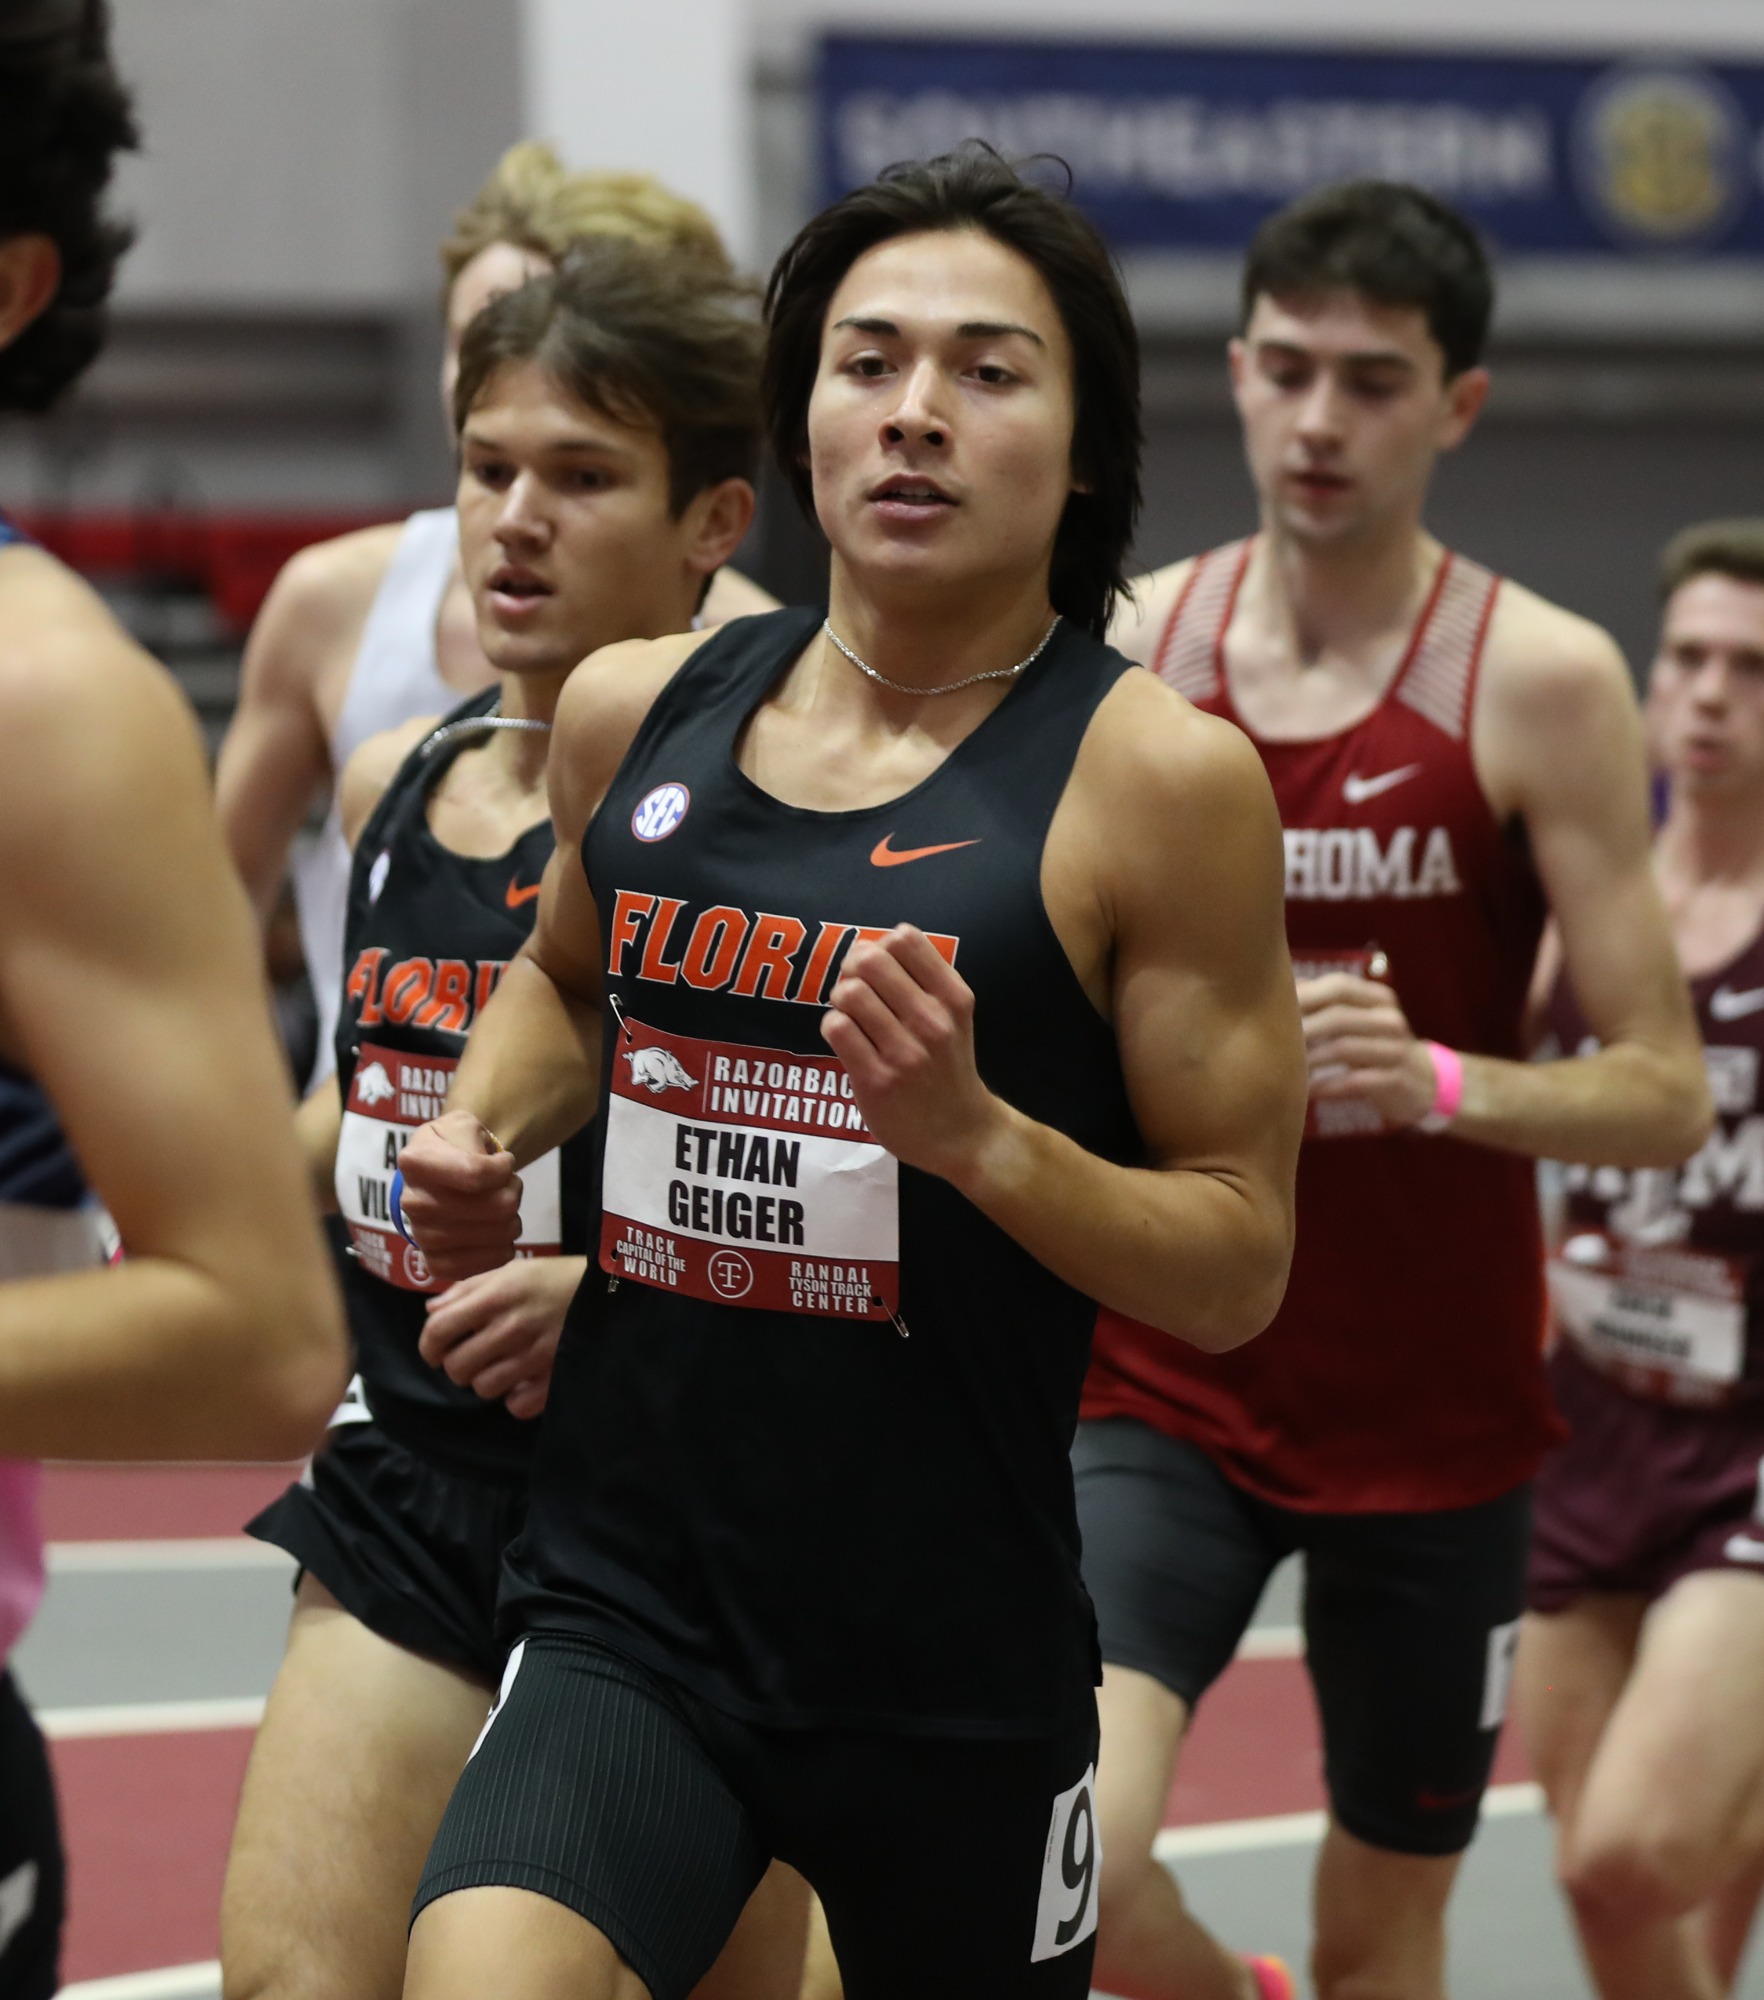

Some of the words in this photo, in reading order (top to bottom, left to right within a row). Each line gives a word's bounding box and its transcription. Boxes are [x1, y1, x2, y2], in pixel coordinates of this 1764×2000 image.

[635, 786, 686, 838] SEC
[1284, 826, 1461, 899] HOMA
[608, 889, 960, 1008] FLORI
[714, 1055, 854, 1099] RAZORBAC
[711, 1086, 870, 1132] INVITATION
[675, 1123, 801, 1188] ETHAN
[357, 1174, 391, 1221] VIL
[668, 1179, 805, 1246] GEIGER
[616, 1239, 654, 1263] CAPITAL
[654, 1251, 667, 1267] OF
[667, 1255, 687, 1273] THE
[626, 1226, 676, 1256] TRACK
[624, 1255, 678, 1286] WORLD
[788, 1276, 829, 1294] TYSON
[830, 1281, 872, 1298] TRACK
[791, 1260, 870, 1284] RANDAL
[792, 1290, 868, 1314] CENTER
[1054, 1785, 1095, 1945] 9
